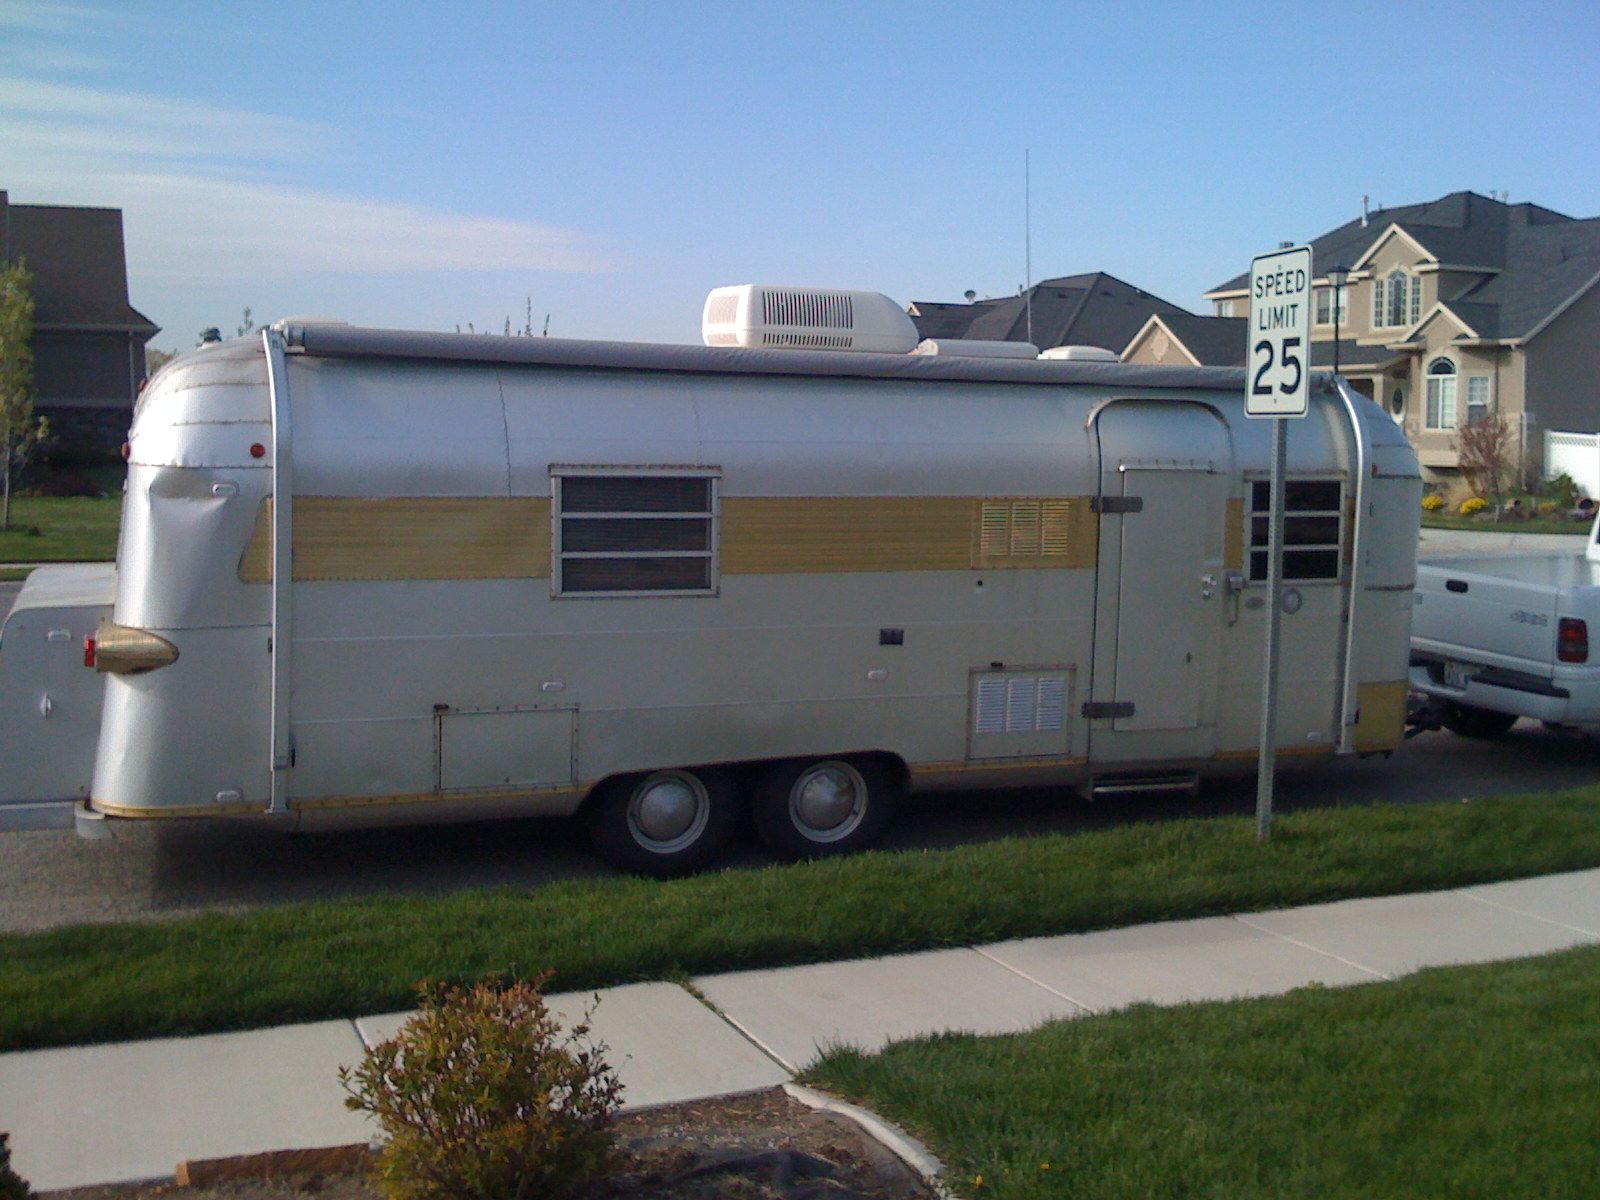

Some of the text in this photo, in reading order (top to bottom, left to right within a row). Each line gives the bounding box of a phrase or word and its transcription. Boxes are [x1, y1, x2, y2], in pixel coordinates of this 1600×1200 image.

[1255, 268, 1306, 299] SPEED
[1259, 303, 1299, 331] LIMIT
[1252, 336, 1301, 395] 25
